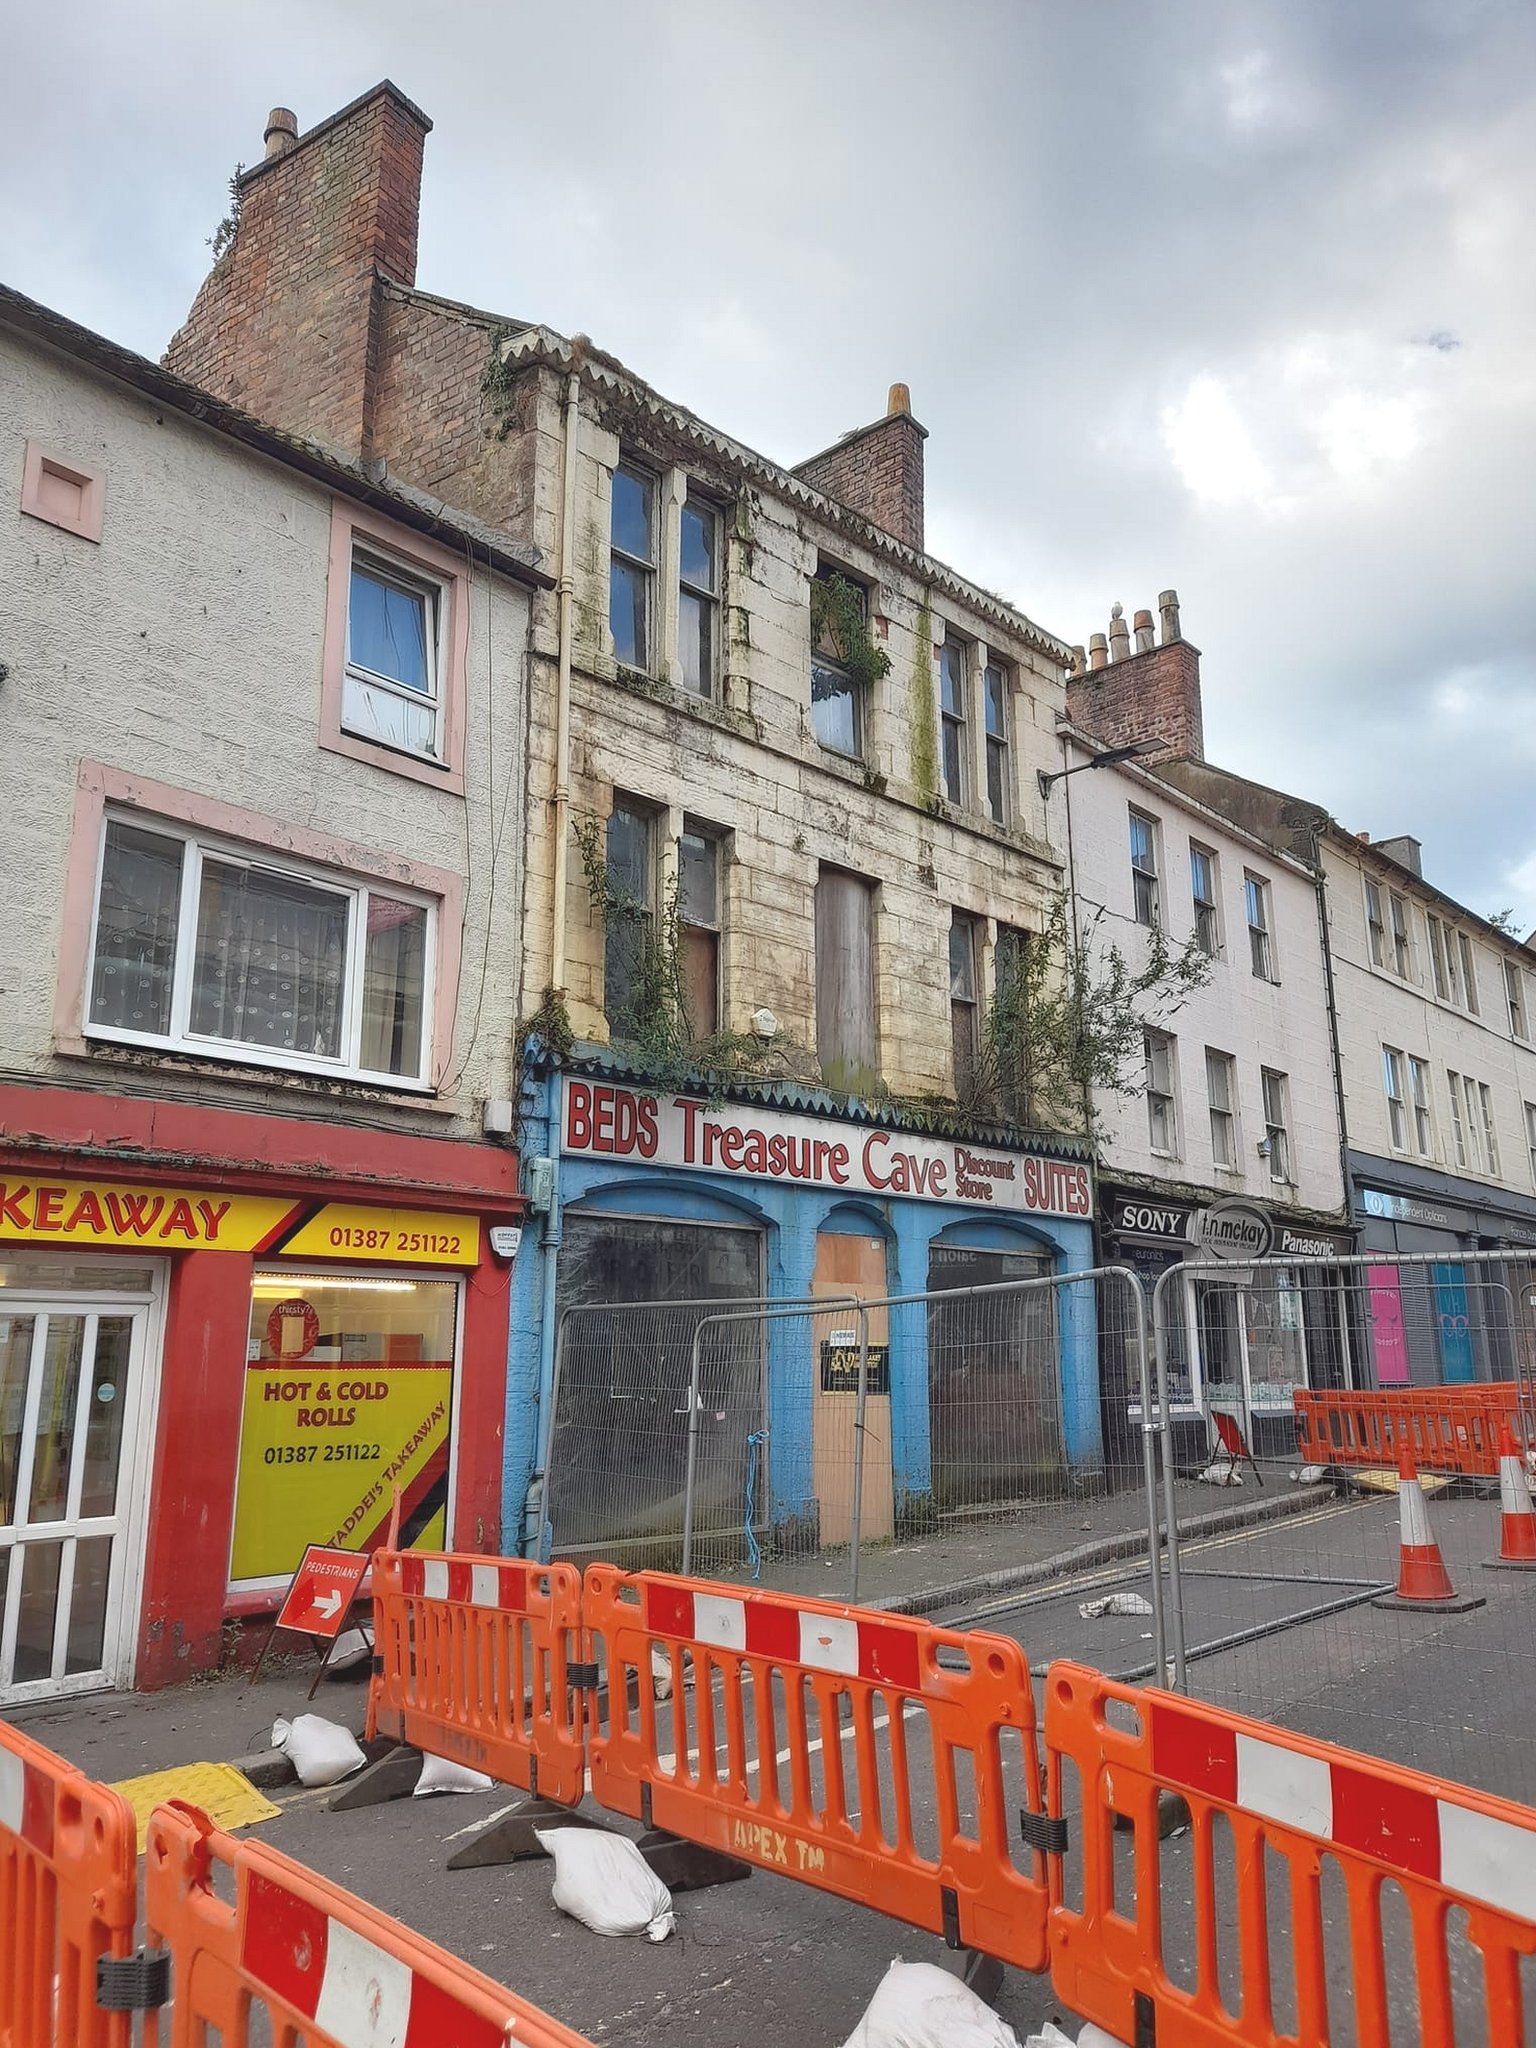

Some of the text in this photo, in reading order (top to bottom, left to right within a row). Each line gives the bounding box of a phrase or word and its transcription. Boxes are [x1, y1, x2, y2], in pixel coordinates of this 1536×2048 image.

[567, 1081, 659, 1158] BEDS
[672, 1097, 948, 1198] Treasure Cave
[954, 1147, 1016, 1181] Discount
[955, 1174, 993, 1201] Store
[1023, 1157, 1091, 1216] SUITES
[1122, 1205, 1182, 1234] SONY
[329, 1226, 460, 1254] 01387 251122
[1281, 1229, 1334, 1256] Panasonic
[278, 1303, 311, 1316] thirsty?
[264, 1381, 389, 1401] HOT & COLD
[296, 1407, 356, 1428] ROLLS
[264, 1444, 381, 1464] 01387 251122
[381, 1400, 446, 1484] TAKEAWAY
[305, 1560, 360, 1580] PEDESTRIANS
[734, 1819, 826, 1873] APEX TM
